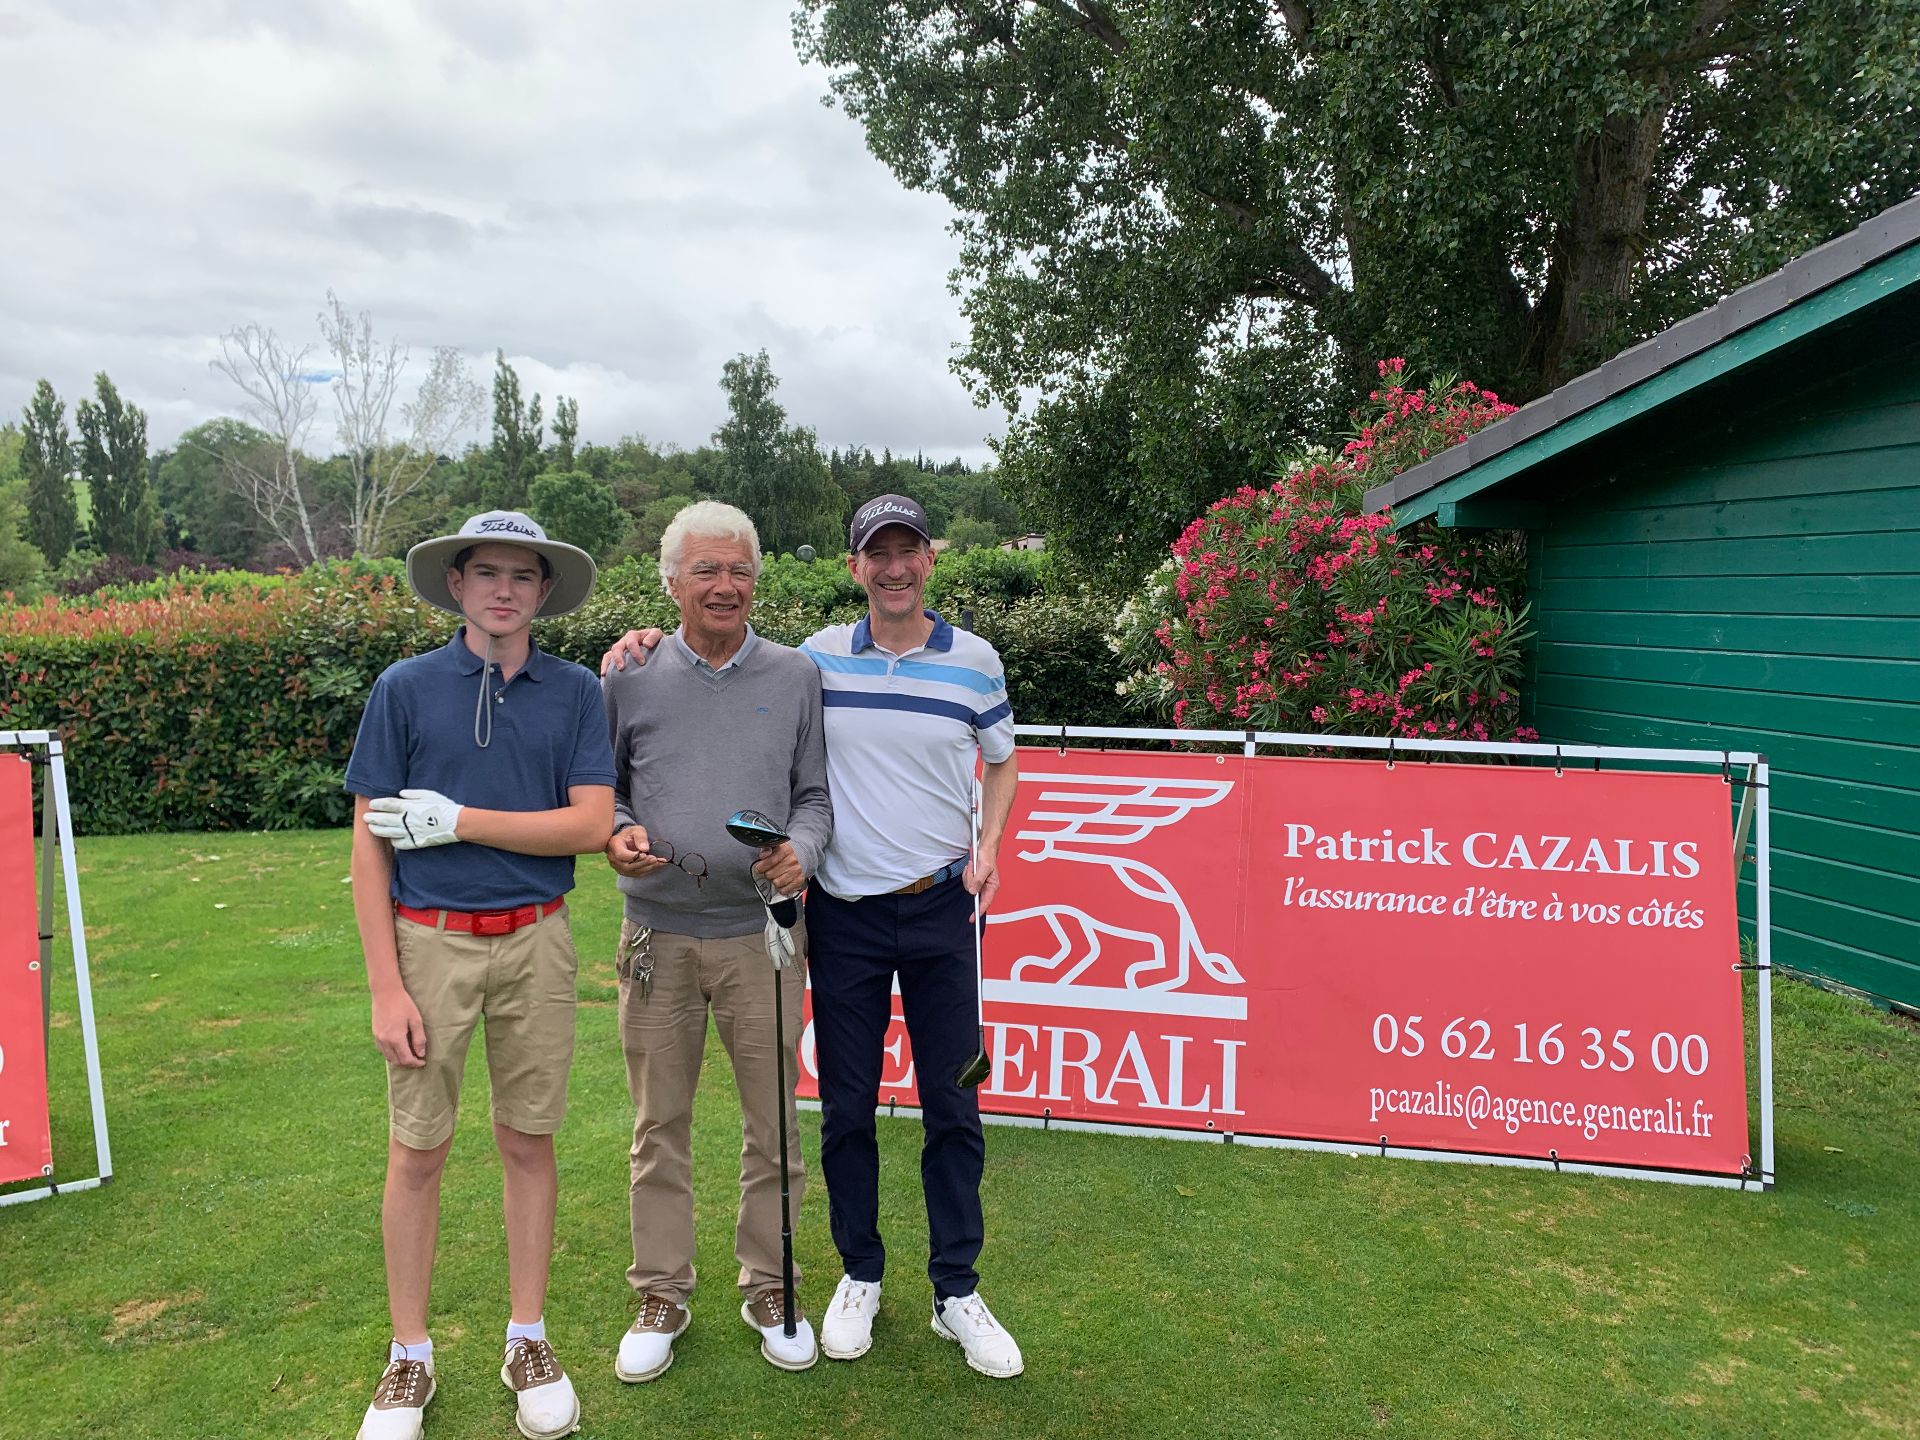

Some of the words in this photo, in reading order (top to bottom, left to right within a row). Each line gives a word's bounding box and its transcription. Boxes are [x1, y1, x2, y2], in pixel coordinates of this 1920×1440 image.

[475, 518, 537, 538] Titleist
[860, 501, 918, 529] Titleist
[1283, 823, 1452, 866] Patrick
[1462, 832, 1700, 879] CAZALIS
[1283, 876, 1446, 915] l'assurance
[1452, 886, 1538, 920] d'être
[1543, 893, 1565, 922] à
[1569, 902, 1621, 925] vos
[1627, 898, 1705, 929] côtés
[801, 1015, 1247, 1116] EERALI
[1372, 1013, 1425, 1057] 05
[1440, 1016, 1496, 1060] 62
[1513, 1022, 1565, 1065] 16
[1580, 1027, 1635, 1072] 35
[1651, 1032, 1709, 1076] 00
[1369, 1079, 1714, 1141] pcazalis@agence.generali.fr
